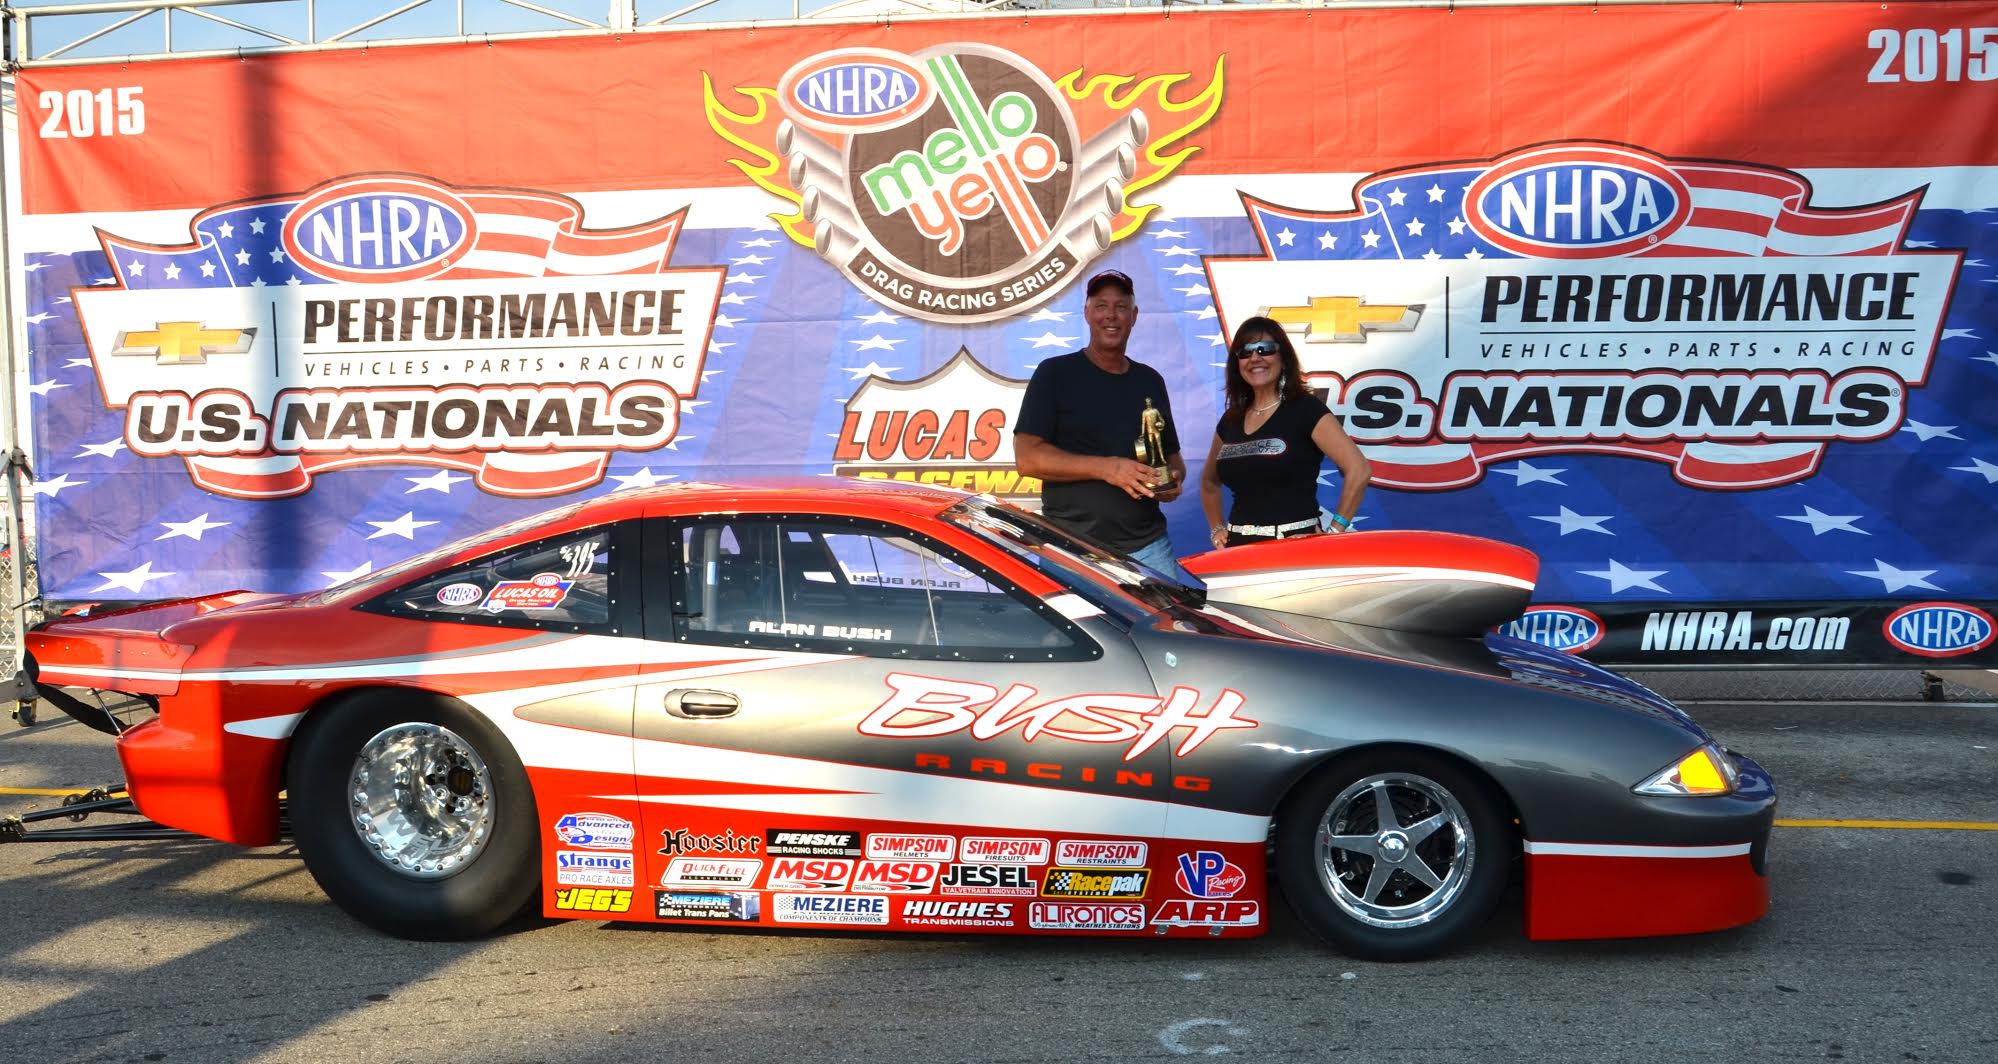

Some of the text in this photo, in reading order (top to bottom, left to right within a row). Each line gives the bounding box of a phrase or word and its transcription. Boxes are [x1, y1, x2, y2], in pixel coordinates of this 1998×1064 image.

[1867, 28, 1998, 82] 2015
[807, 69, 908, 115] NHRA
[39, 87, 145, 139] 2015
[865, 55, 1033, 212] mello
[909, 137, 1058, 255] yello
[1499, 166, 1659, 241] NHRA
[312, 199, 451, 267] NHRA
[860, 257, 1066, 310] DRAG RACING SERIES
[1480, 272, 1921, 323] PERFORMANCE
[303, 289, 685, 344] PERFORMANCE
[1480, 341, 1916, 359] VEHICLES PARTS RACING
[304, 354, 685, 376] VEHICLES PARTS RACING
[1314, 383, 1892, 429] .S. NATIONALS
[135, 395, 669, 443] U.S. NATIONALS
[832, 408, 1006, 462] LUCAS
[444, 587, 476, 601] NHRA
[494, 588, 559, 598] LUCAS OIL
[749, 620, 892, 640] ALAN BUSH
[1508, 611, 1982, 651] NHRA NHRA.com NHRA
[857, 672, 1259, 762] BUSH
[915, 753, 1213, 792] RACING
[557, 816, 631, 829] Advanced
[569, 834, 627, 845] Design
[657, 828, 761, 855] Hoosier
[775, 833, 851, 847] PENSKE
[873, 837, 948, 853] SIMPSON
[967, 840, 1043, 855] SIMPSON
[558, 853, 632, 870] Strange
[782, 846, 844, 856] RACING SHOCKS
[1063, 844, 1140, 858] SIMPSON
[560, 873, 632, 885] PRO RACE AXLES
[774, 861, 849, 881] MSD
[859, 862, 935, 883] MSD
[942, 865, 1032, 888] JESEL
[1178, 851, 1225, 897] VP
[944, 886, 988, 894] VALVETRAIN
[1068, 872, 1144, 896] Racepak
[1208, 876, 1241, 890] Racing
[556, 888, 633, 912] JEG'S
[672, 895, 731, 906] MEZIERE
[794, 897, 885, 913] MEZIERE
[902, 900, 1014, 919] HUGHES
[659, 908, 730, 918] Billet Trans Pans
[839, 915, 882, 923] CHAMPIONS
[902, 917, 1015, 927] TRANSMISSIONS
[1152, 901, 1257, 922] ARP
